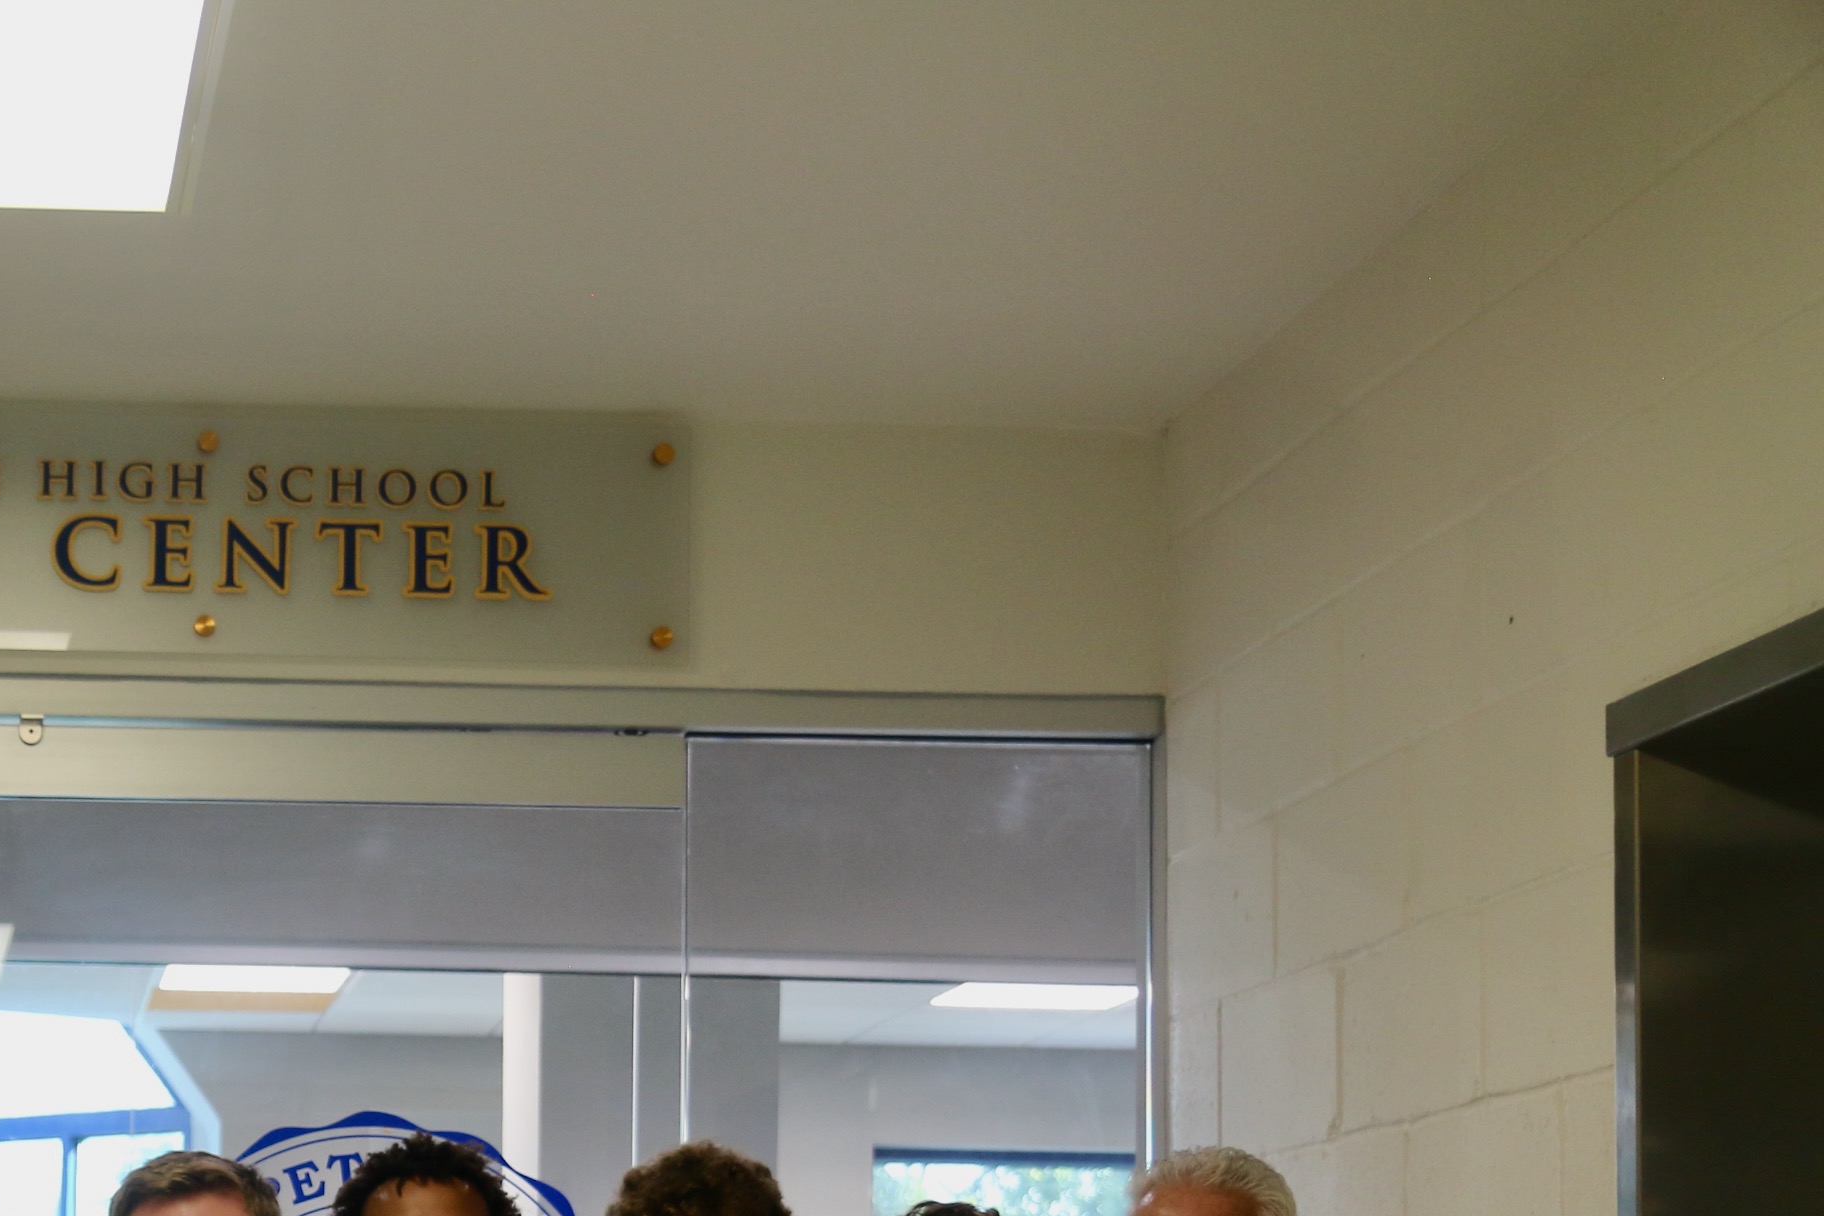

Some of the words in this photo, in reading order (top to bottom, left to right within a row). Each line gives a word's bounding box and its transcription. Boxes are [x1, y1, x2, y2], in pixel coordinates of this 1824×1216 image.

[38, 458, 207, 502] HIGH
[246, 464, 506, 510] SCHOOL
[50, 511, 551, 601] CENTER
